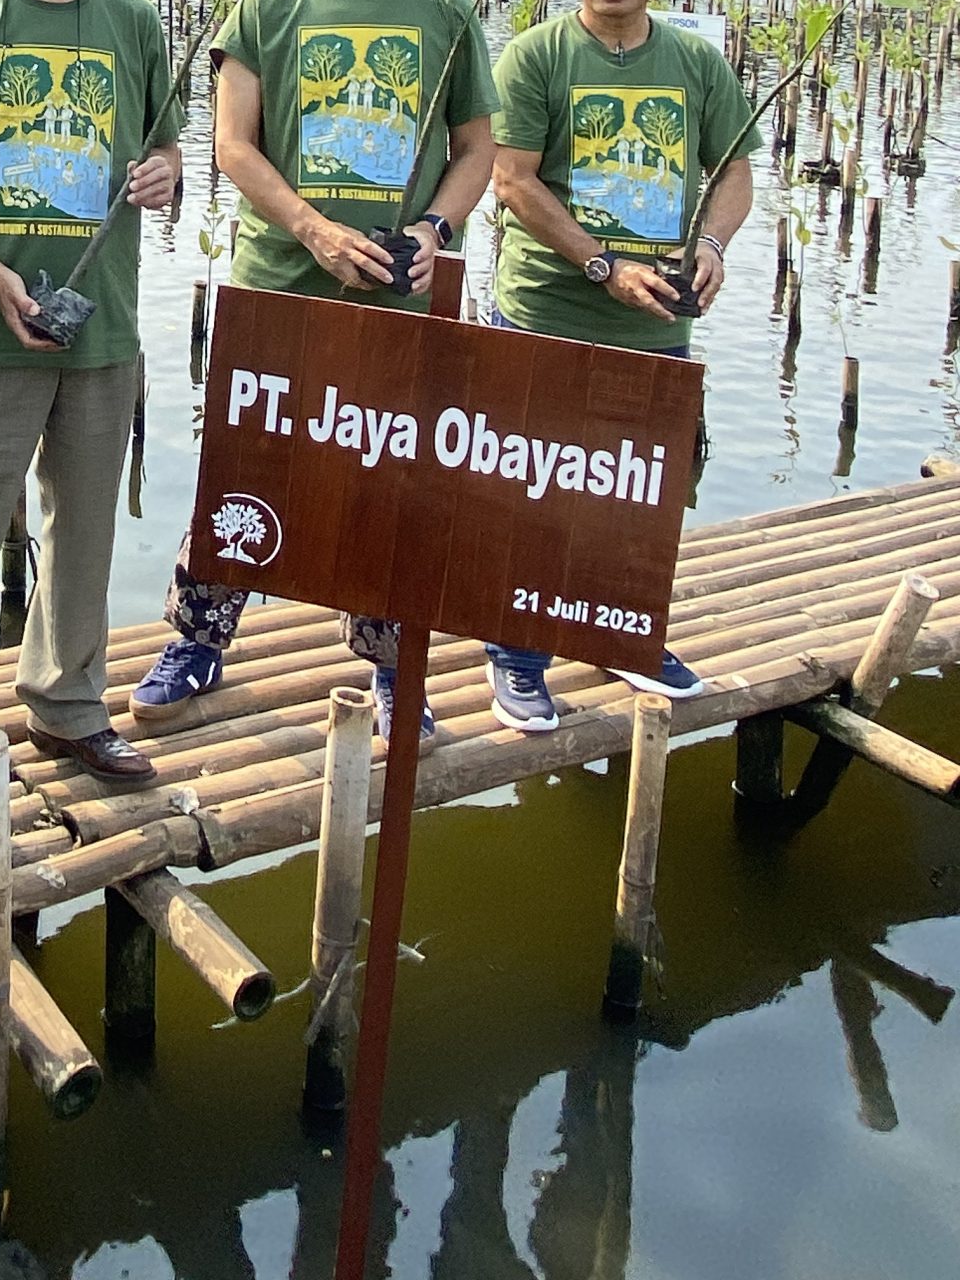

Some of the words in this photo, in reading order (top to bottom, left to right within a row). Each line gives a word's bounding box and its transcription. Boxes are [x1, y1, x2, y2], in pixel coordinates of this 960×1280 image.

[331, 188, 337, 198] A
[339, 189, 388, 201] SUSTAINABLE
[29, 224, 36, 234] A
[37, 224, 91, 237] SUSTAINABLE
[228, 369, 293, 435] PT.
[307, 386, 419, 468] Jaya
[434, 407, 666, 507] Obayashi
[513, 588, 539, 613] 21
[547, 596, 590, 624] Juli
[594, 603, 653, 636] 2023
